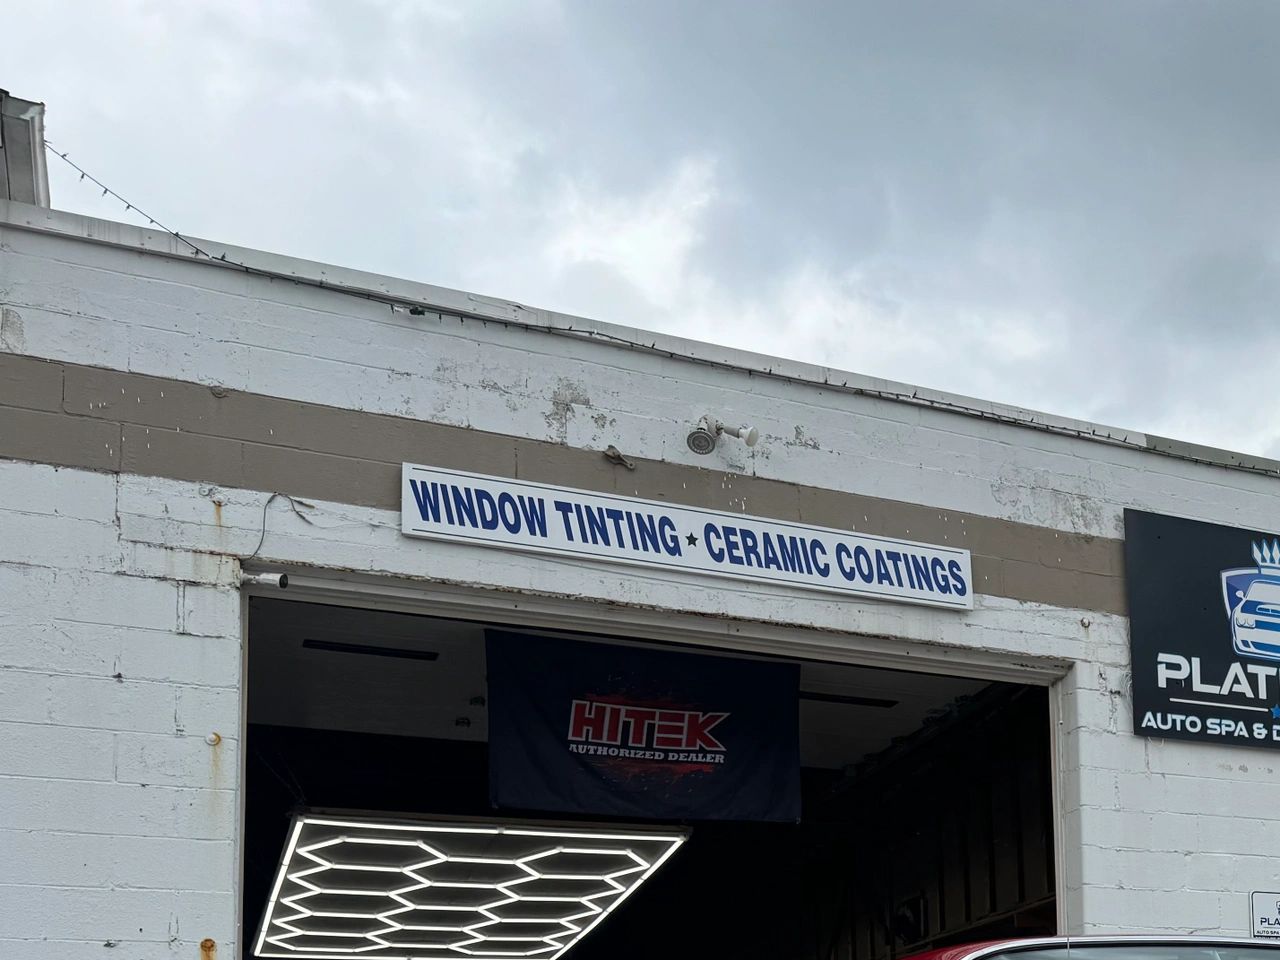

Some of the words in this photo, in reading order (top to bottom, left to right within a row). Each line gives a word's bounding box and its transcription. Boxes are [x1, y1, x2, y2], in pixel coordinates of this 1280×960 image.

[409, 479, 548, 538] WINDOW
[554, 501, 683, 557] TINTING
[703, 522, 830, 578] CERAMIC
[836, 545, 967, 597] COATINGS
[567, 700, 731, 751] HITEK
[1141, 711, 1202, 733] AUTO
[1206, 719, 1249, 738] SPA
[1253, 723, 1268, 739] &
[569, 744, 665, 761] AUTHORIZED
[668, 751, 725, 764] DEALER
